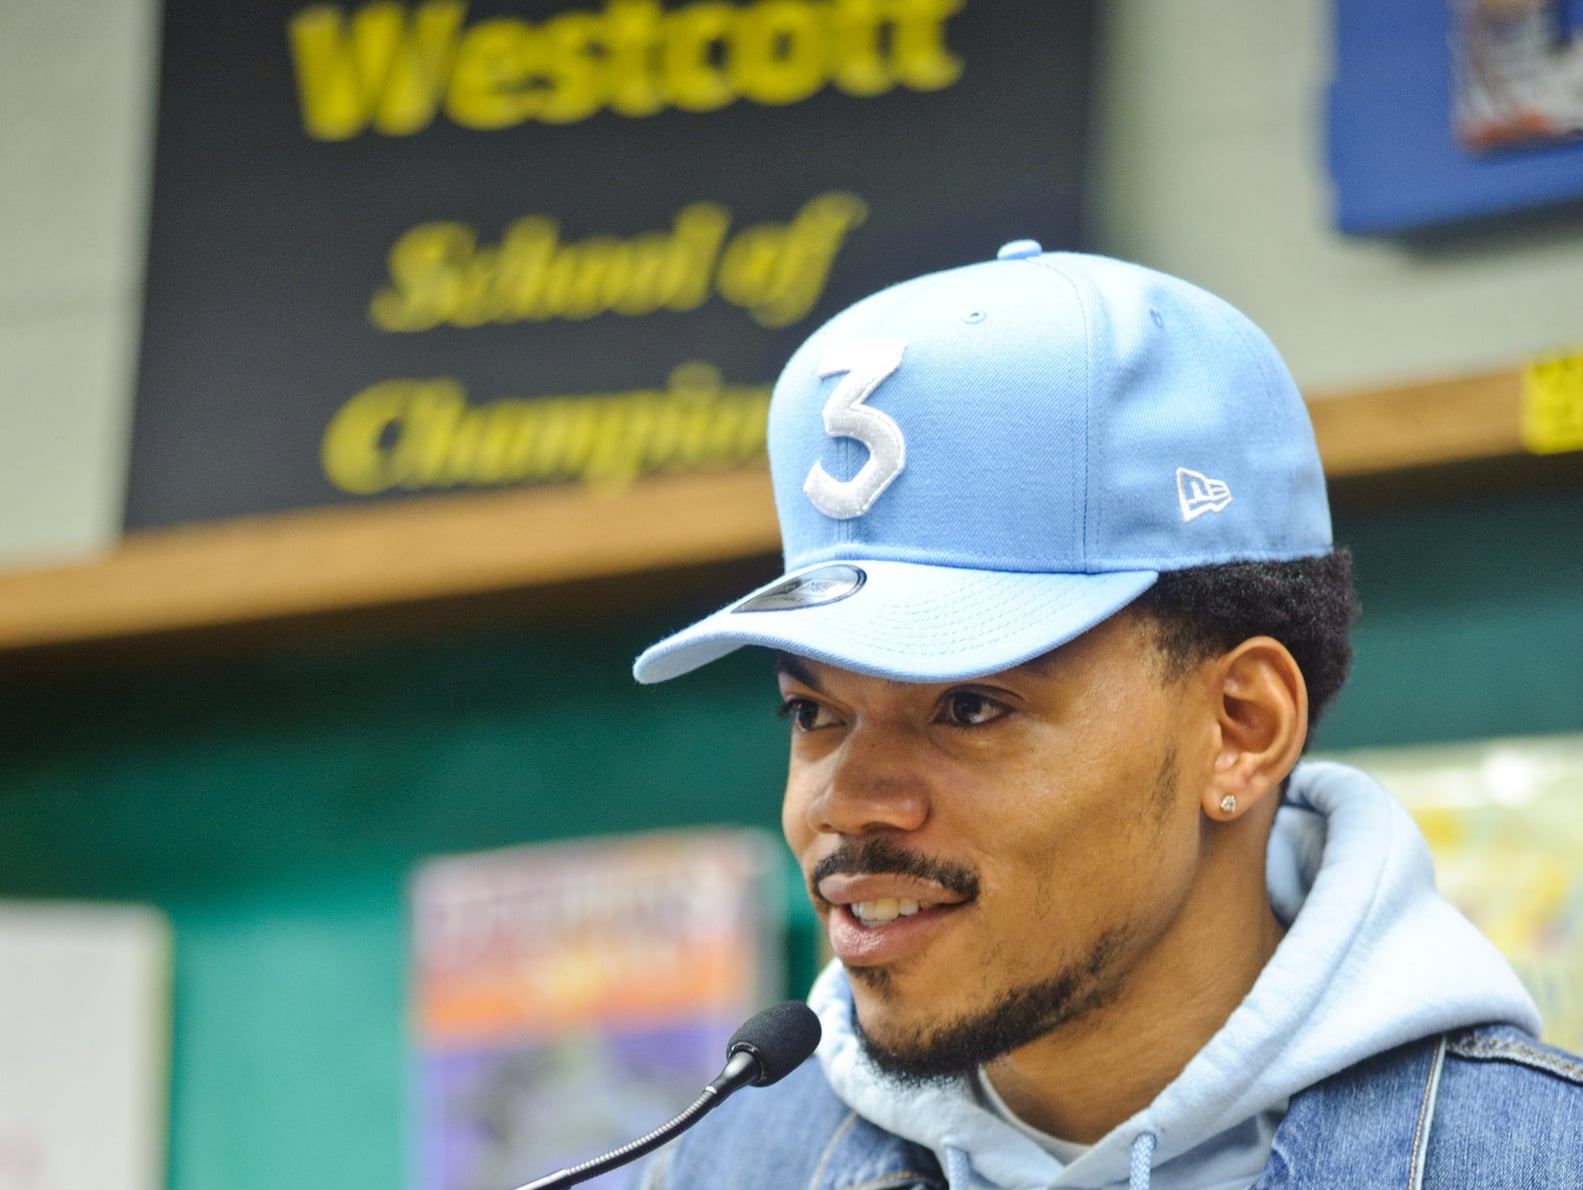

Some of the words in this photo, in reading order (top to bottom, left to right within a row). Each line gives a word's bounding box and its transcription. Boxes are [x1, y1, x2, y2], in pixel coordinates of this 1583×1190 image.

[291, 0, 965, 139] Westcott
[370, 203, 731, 331] School
[717, 192, 868, 328] of
[803, 339, 907, 519] 3
